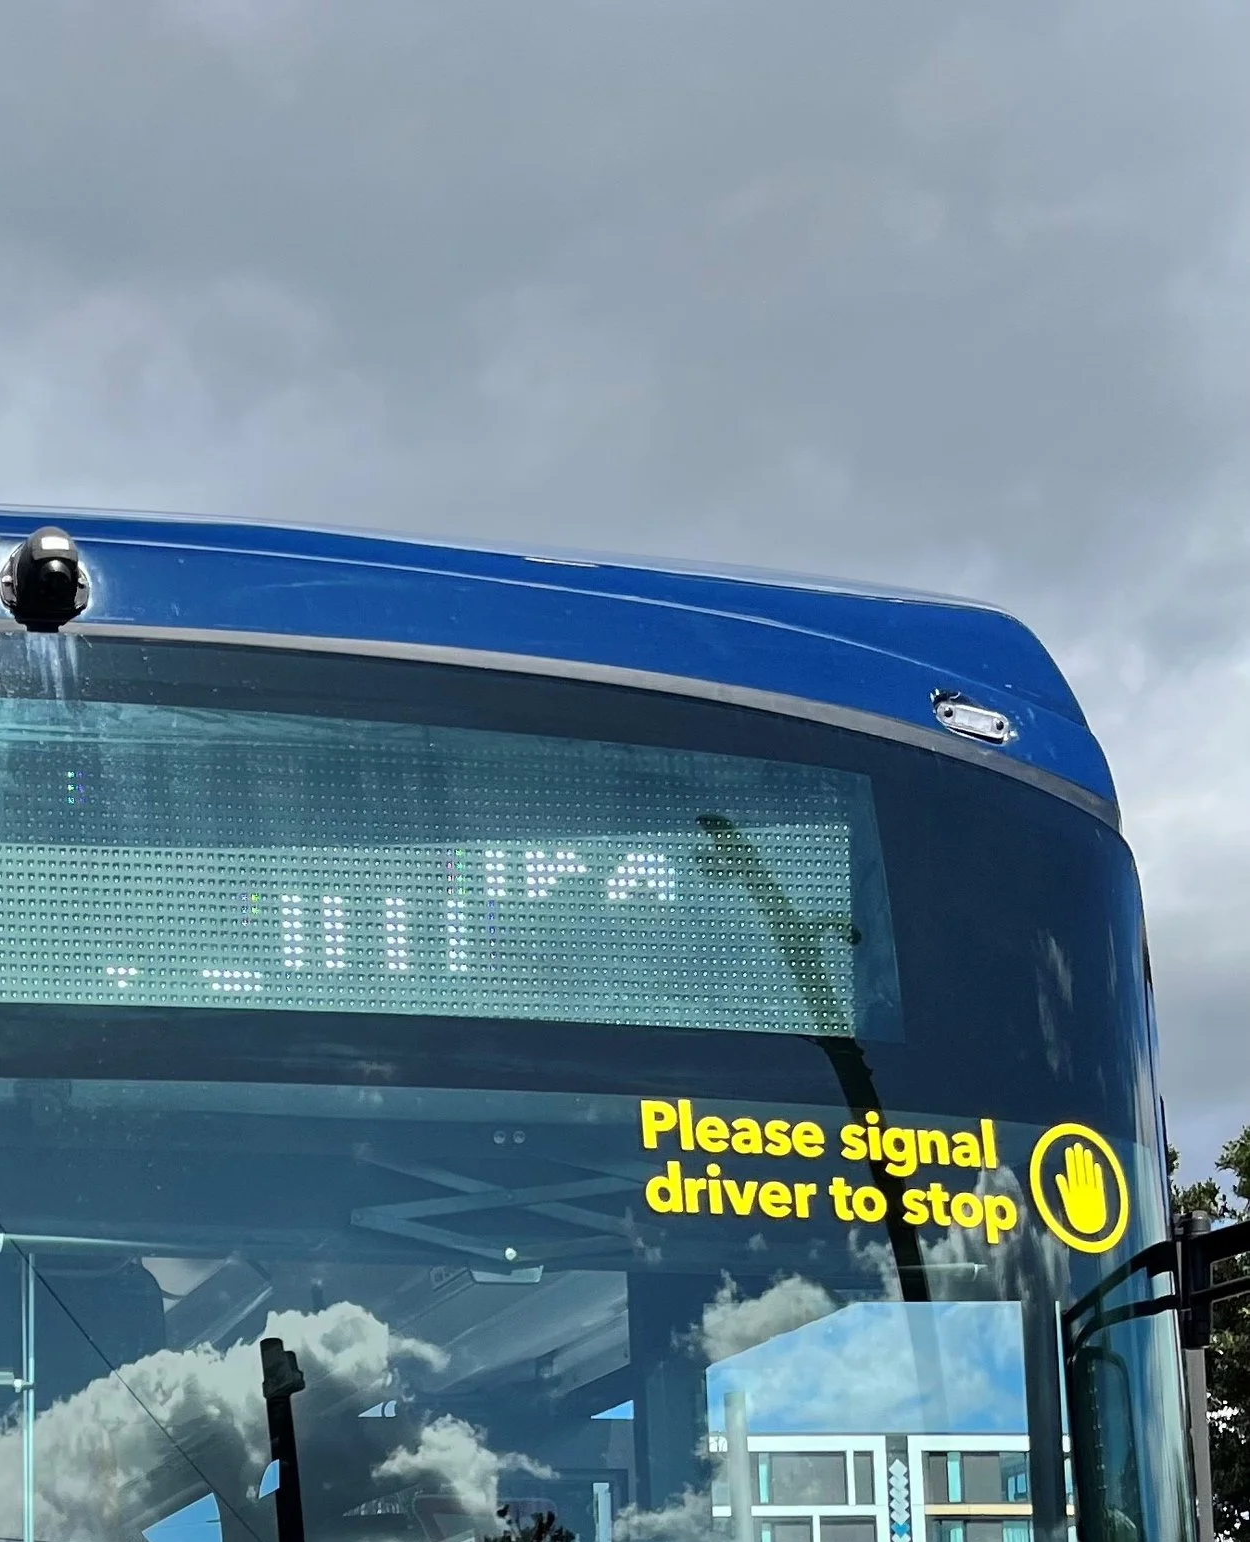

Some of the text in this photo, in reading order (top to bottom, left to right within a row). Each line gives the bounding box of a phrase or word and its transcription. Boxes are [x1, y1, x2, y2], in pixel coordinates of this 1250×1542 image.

[640, 1099, 997, 1178] Please signal
[645, 1160, 1018, 1244] driver to stop
